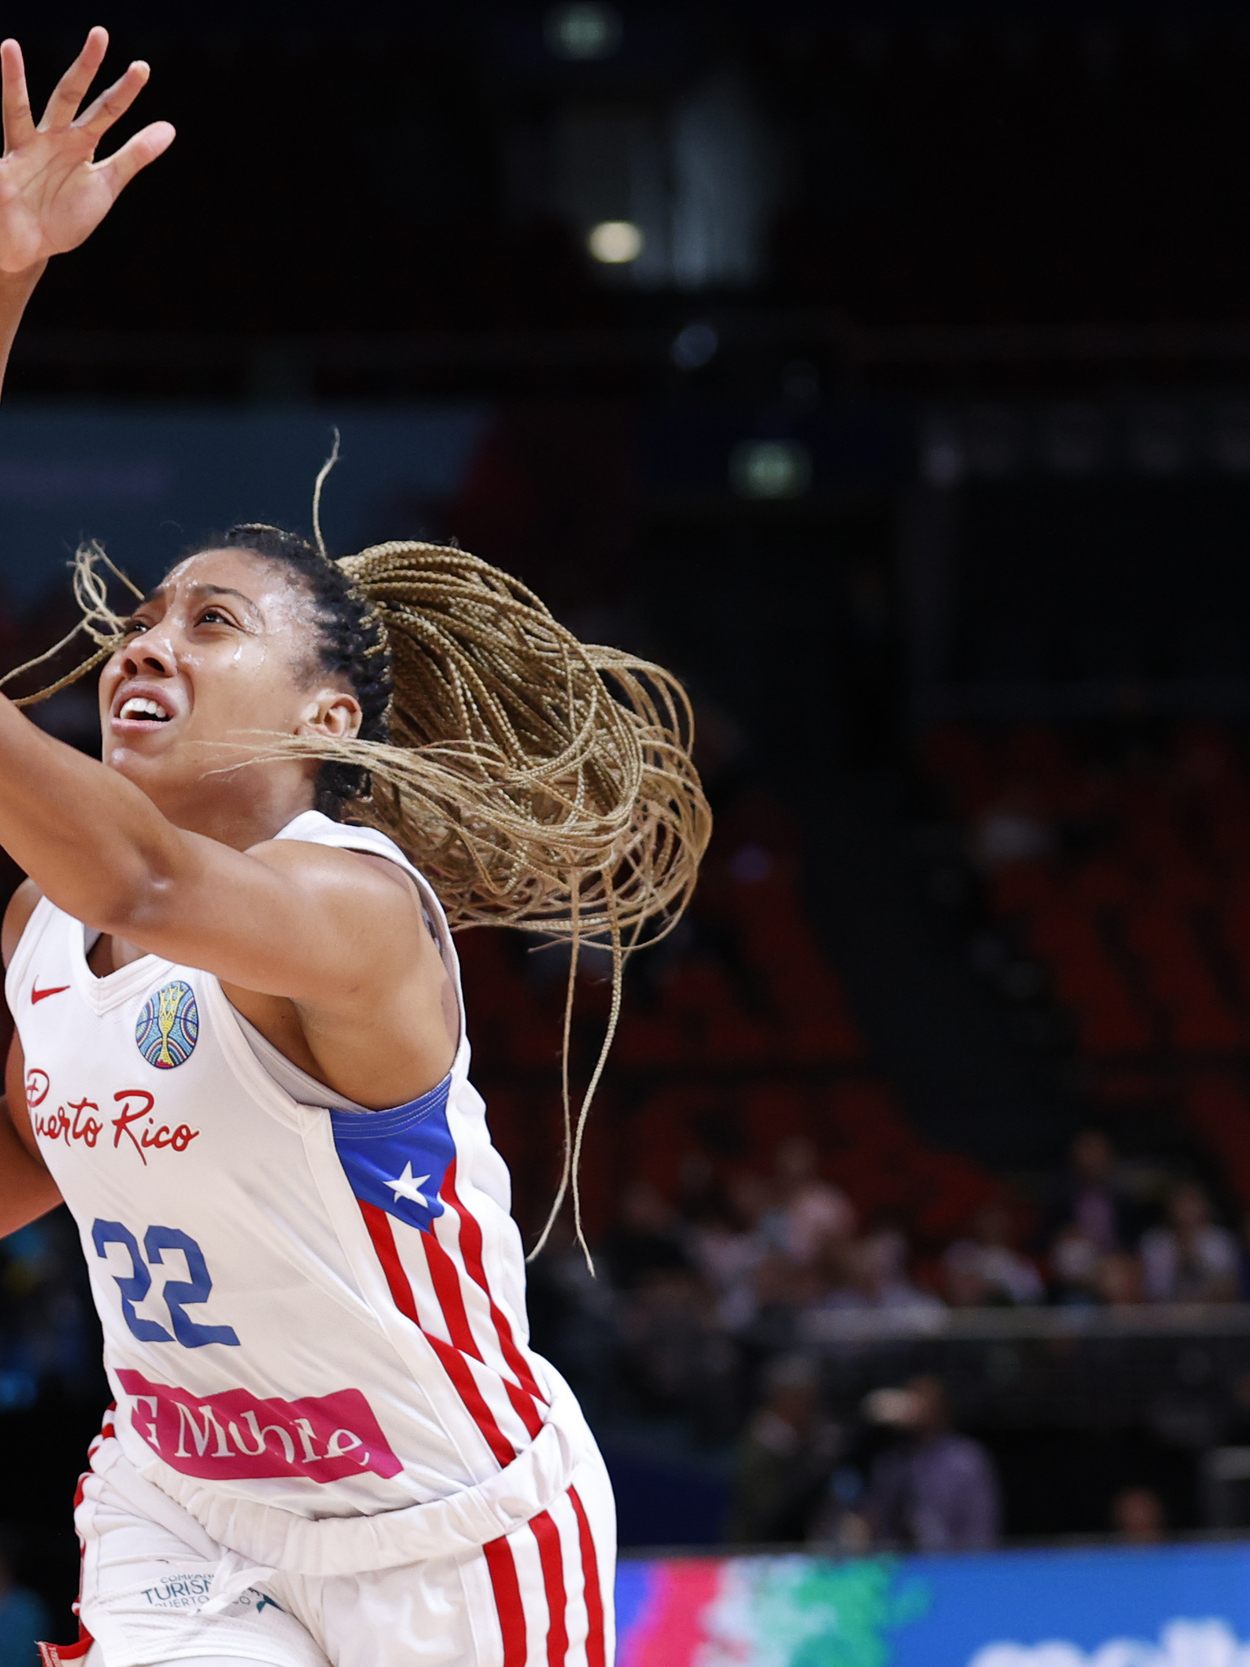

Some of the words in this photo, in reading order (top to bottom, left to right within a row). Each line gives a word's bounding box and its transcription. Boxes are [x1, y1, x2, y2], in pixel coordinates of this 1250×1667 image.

[26, 1068, 104, 1148] Puerto
[111, 1089, 200, 1167] Rico
[92, 1217, 241, 1348] 22
[141, 1579, 212, 1605] TURIS
